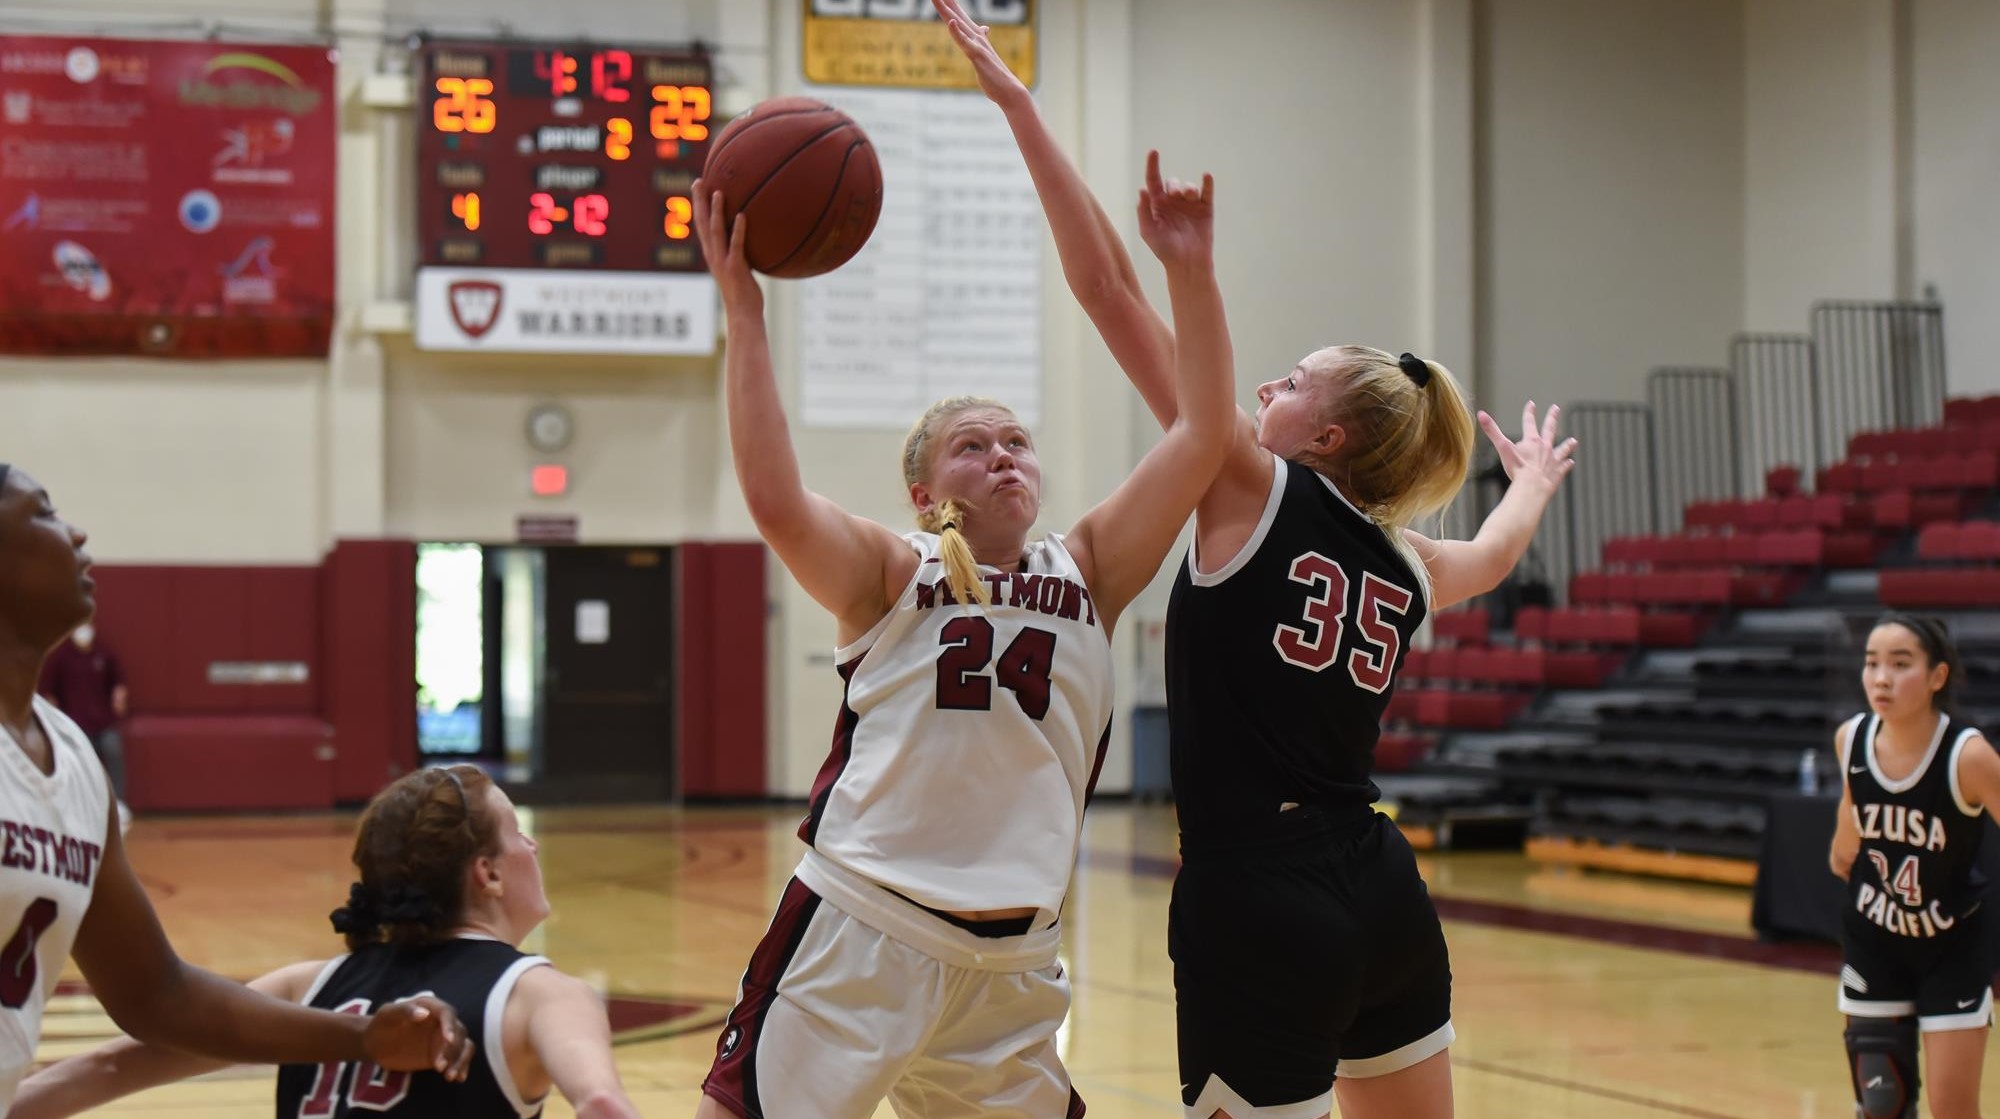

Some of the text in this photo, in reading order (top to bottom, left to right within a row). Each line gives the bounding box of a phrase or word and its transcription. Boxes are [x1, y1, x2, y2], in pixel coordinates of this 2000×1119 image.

[434, 78, 496, 133] 26
[650, 86, 710, 140] 22
[605, 117, 633, 161] 2
[664, 196, 692, 239] 2
[518, 310, 690, 339] WARRIORS
[916, 572, 1096, 627] WETMONT
[1272, 550, 1413, 694] 35
[936, 615, 1057, 722] 24
[1856, 882, 1955, 938] PACIFIC
